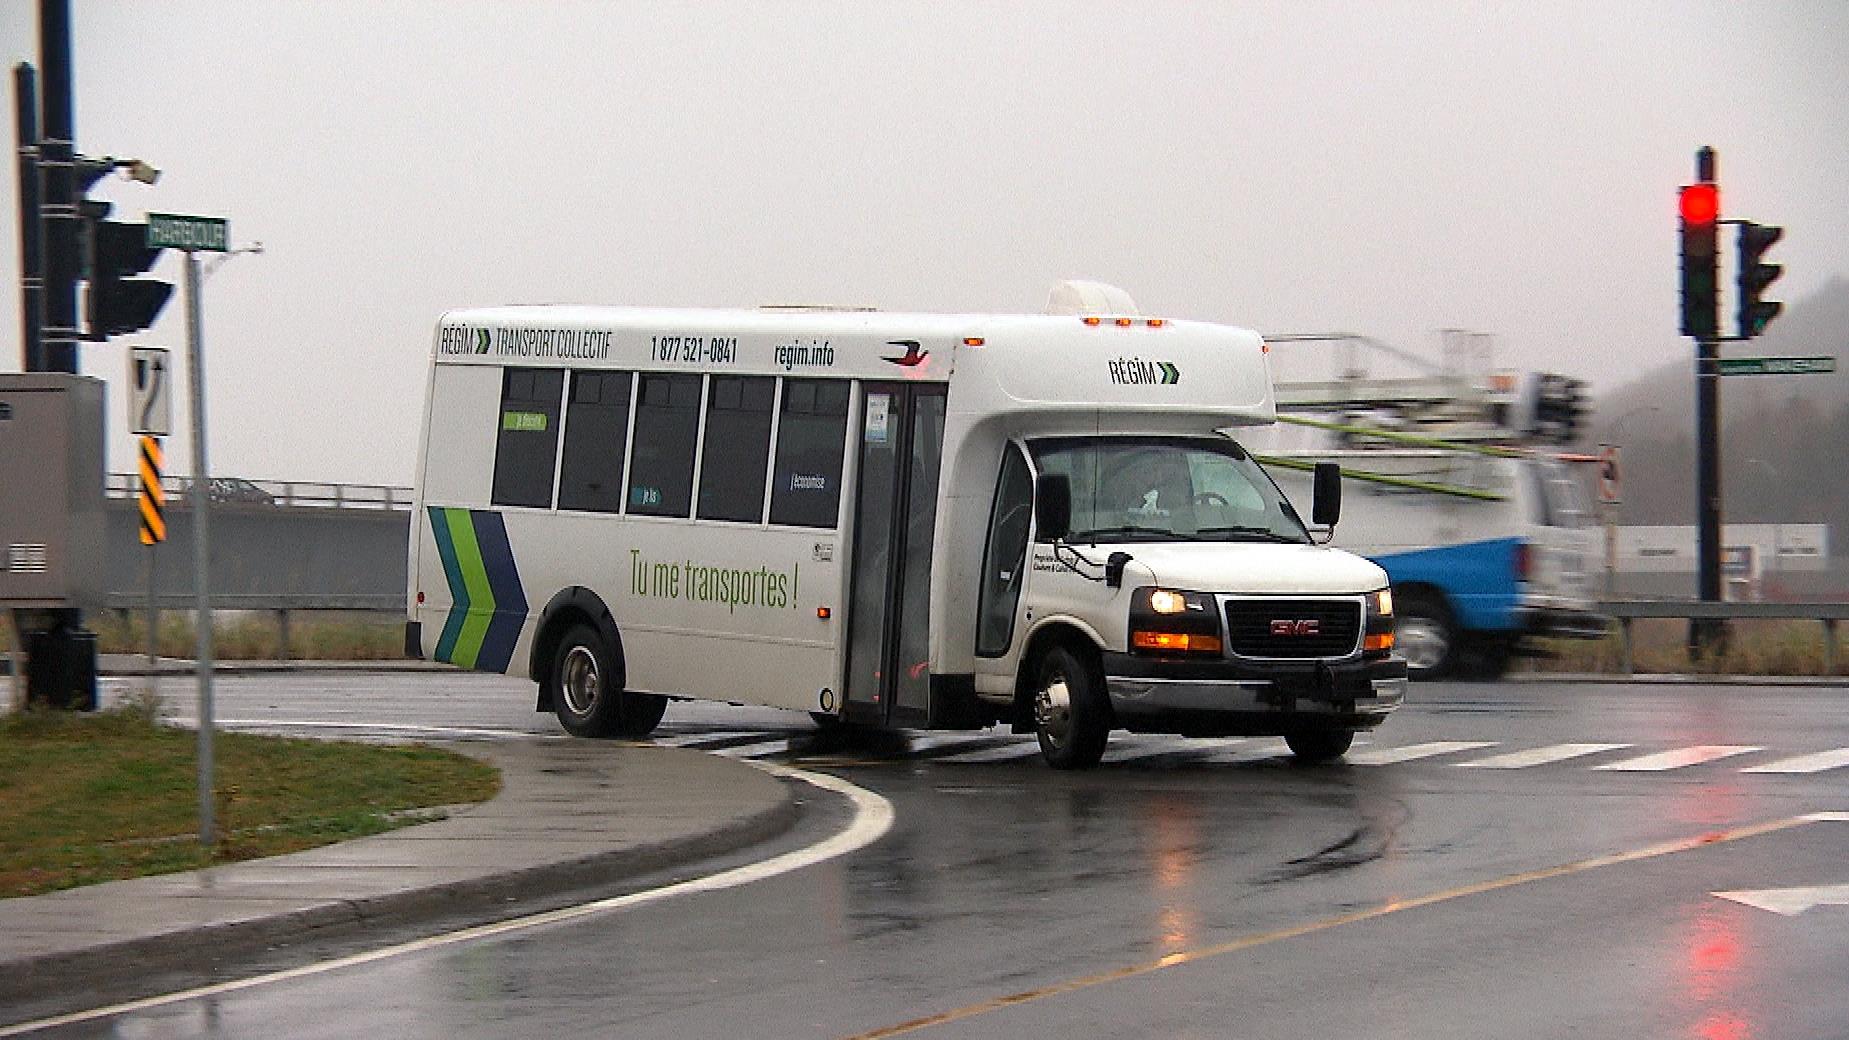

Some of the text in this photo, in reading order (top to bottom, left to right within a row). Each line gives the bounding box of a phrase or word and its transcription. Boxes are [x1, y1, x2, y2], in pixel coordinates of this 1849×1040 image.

[496, 328, 556, 357] TRANSPORT
[557, 329, 612, 360] COLLECTIF
[651, 336, 737, 363] 1 877 521-0841
[774, 339, 834, 371] regim.info
[630, 549, 798, 615] Tu me transportes !
[1270, 619, 1320, 636] GMC
